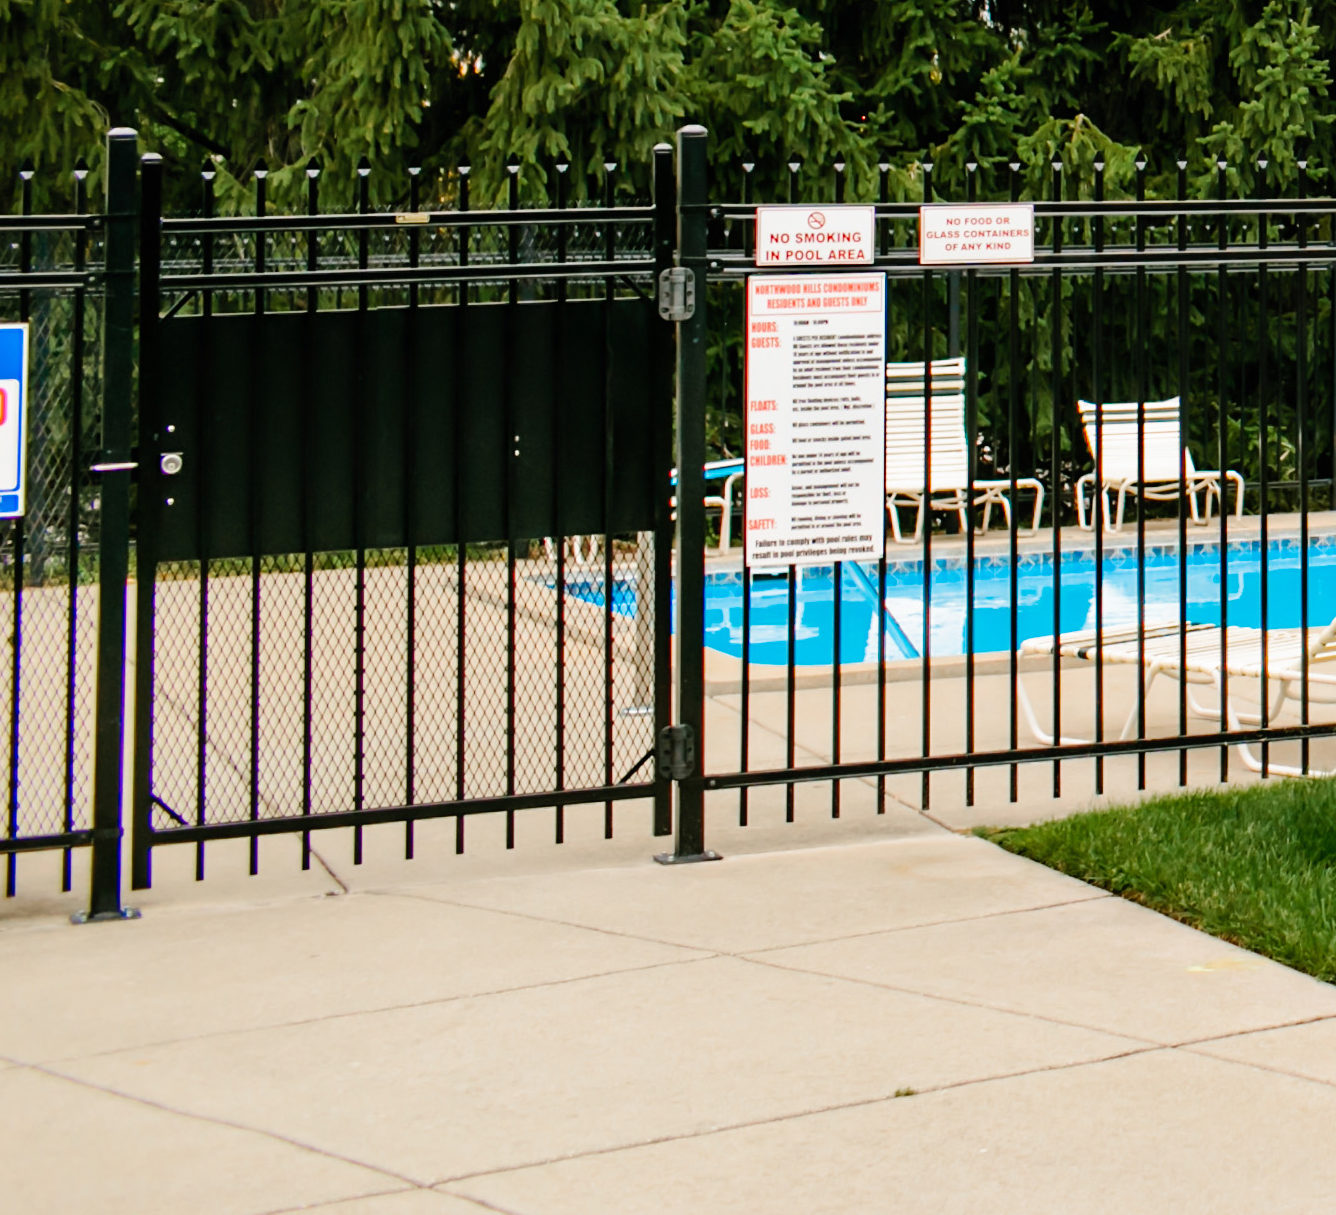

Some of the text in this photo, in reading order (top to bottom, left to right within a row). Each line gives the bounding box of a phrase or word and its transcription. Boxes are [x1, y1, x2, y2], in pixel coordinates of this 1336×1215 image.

[770, 232, 861, 244] NO SMOKING
[964, 229, 1029, 238] CONTAINERS
[766, 249, 865, 261] IN POOL AREA
[755, 282, 879, 294] NORTHWOOD HILLS CONDOMINIUMS
[767, 297, 867, 309] RESIDENTS AND GUESTS ONLY
[751, 337, 781, 348] GUESTS:
[750, 400, 778, 411] FLOATS:
